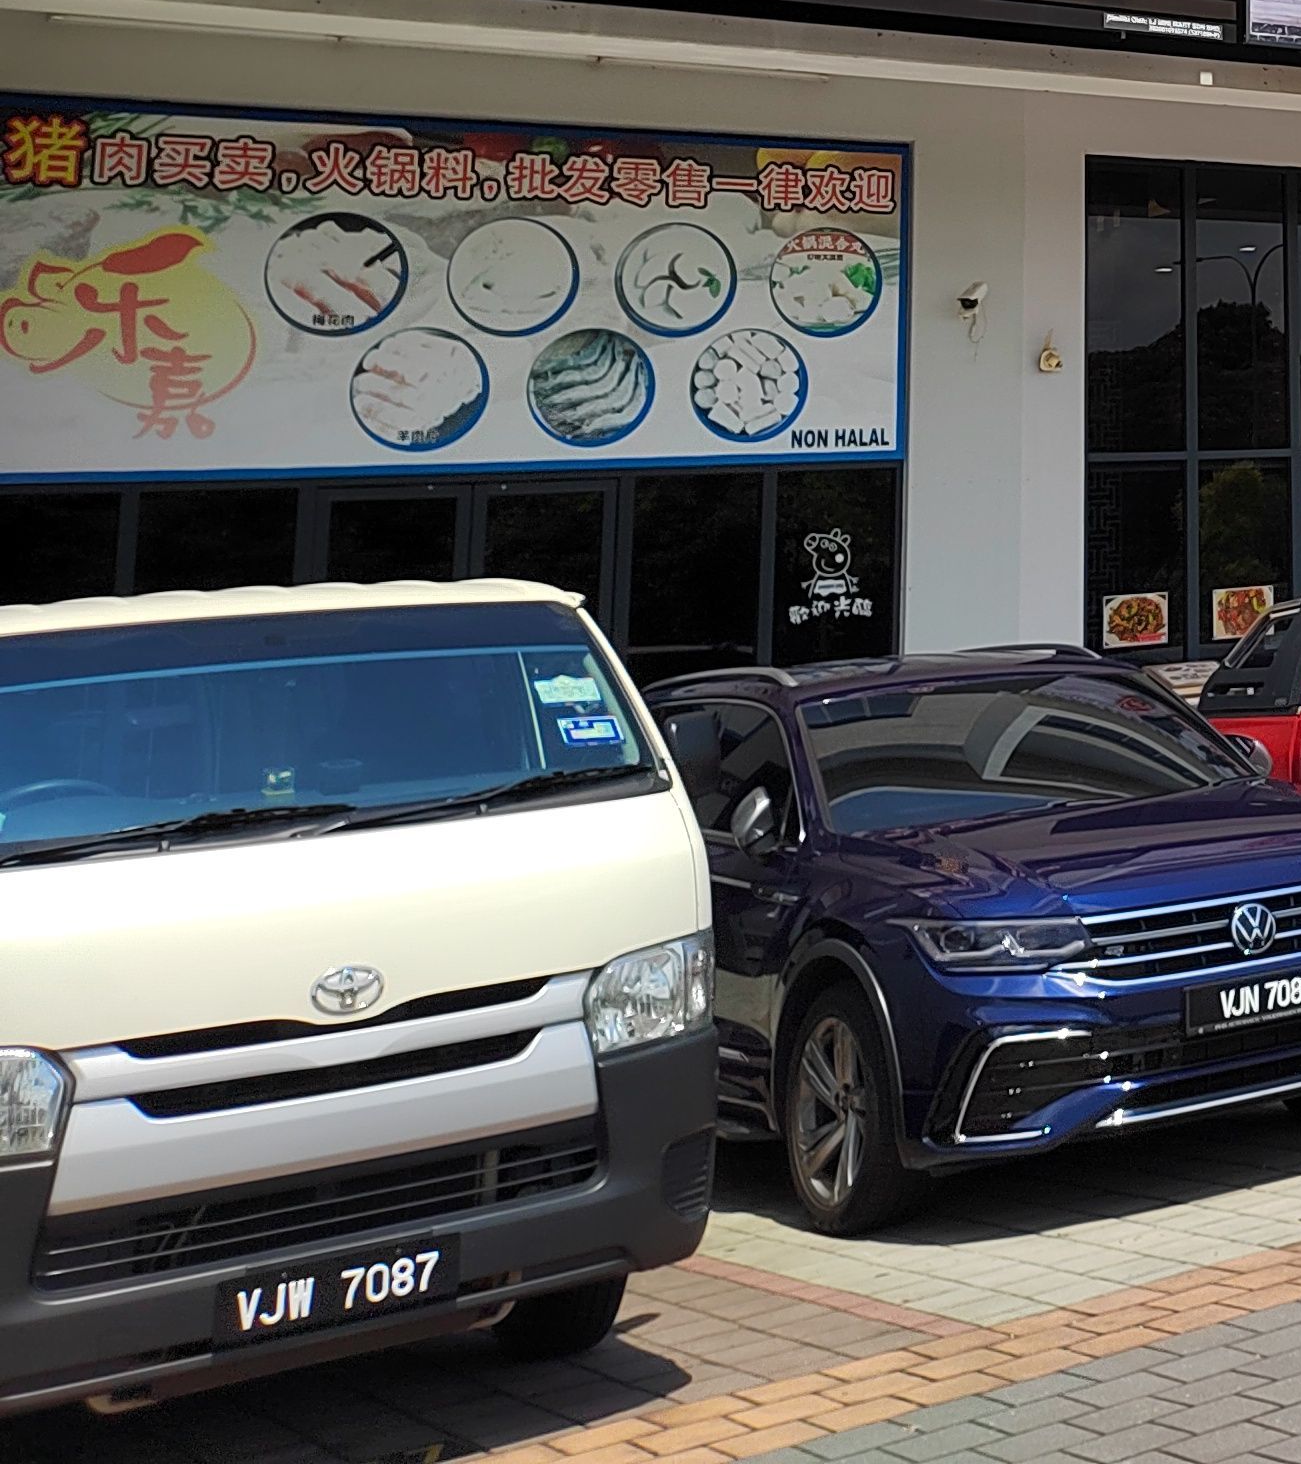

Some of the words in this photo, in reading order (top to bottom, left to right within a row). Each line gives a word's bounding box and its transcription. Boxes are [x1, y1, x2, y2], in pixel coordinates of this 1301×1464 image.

[790, 429, 828, 448] NON
[834, 427, 890, 447] HALAL
[1220, 983, 1260, 1019] VJN
[236, 1274, 314, 1332] VJW
[341, 1249, 440, 1311] 7087
